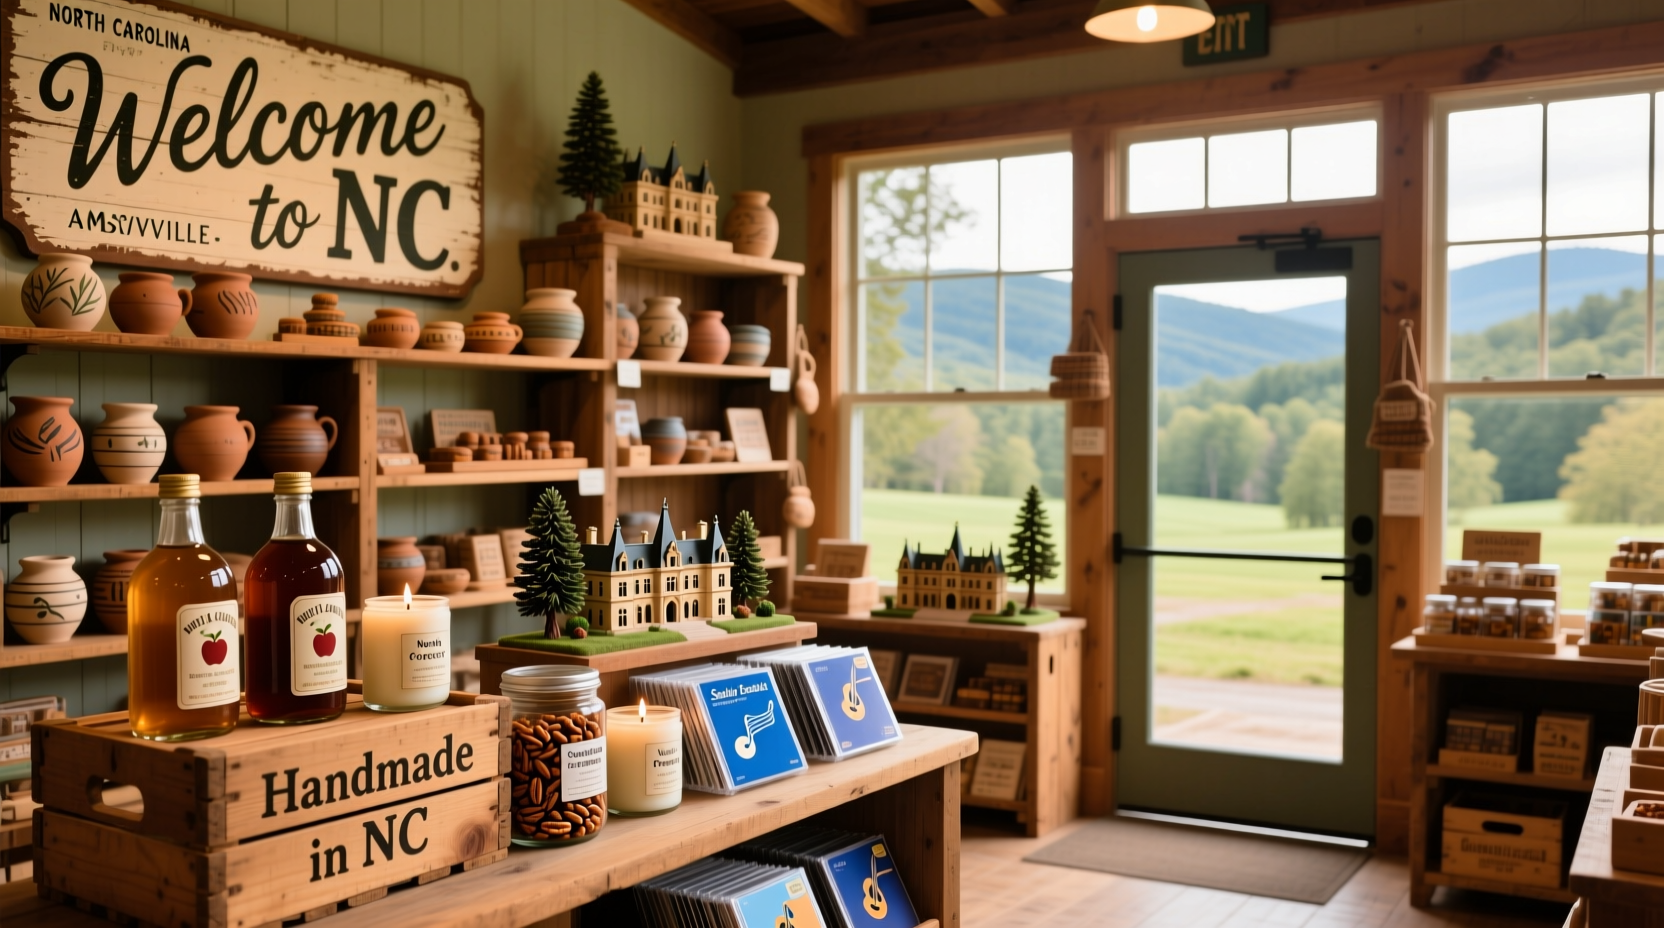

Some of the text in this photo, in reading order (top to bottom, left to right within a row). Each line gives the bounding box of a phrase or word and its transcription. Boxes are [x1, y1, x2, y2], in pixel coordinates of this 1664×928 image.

[49, 2, 105, 34] NORTH
[112, 17, 191, 54] CAROLINA
[39, 52, 446, 190] Welcome
[249, 168, 460, 272] to NC.
[261, 733, 474, 819] Handmade
[309, 806, 429, 883] in NC
